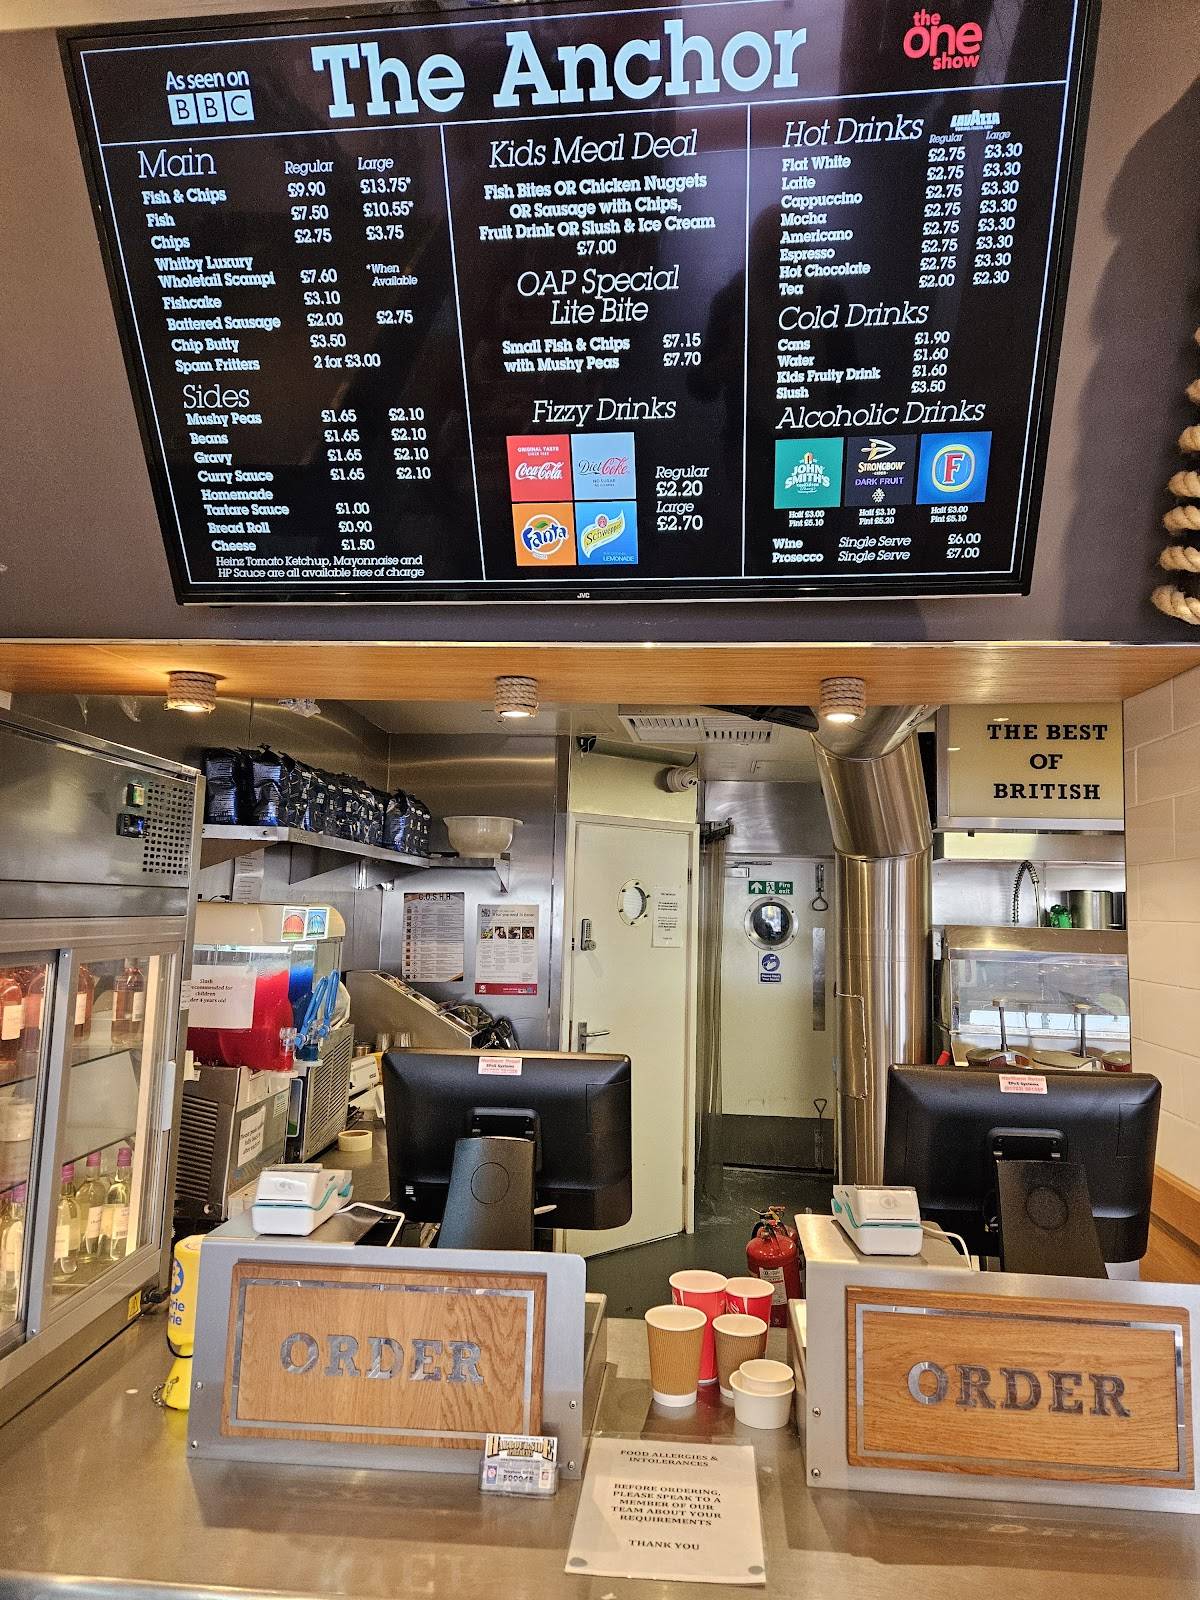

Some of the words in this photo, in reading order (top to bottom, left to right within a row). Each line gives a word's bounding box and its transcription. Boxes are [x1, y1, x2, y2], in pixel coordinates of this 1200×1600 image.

[913, 9, 940, 26] the
[903, 22, 982, 58] one
[933, 52, 979, 70] show
[310, 42, 465, 119] The
[493, 19, 807, 107] Anchor
[166, 72, 186, 91] As
[187, 72, 224, 89] seen
[227, 70, 249, 87] on
[171, 92, 252, 122] BBC
[783, 119, 830, 148] Hot
[835, 114, 924, 145] Drinks
[489, 139, 546, 168] Kids
[552, 133, 624, 164] Meal
[632, 129, 698, 160] Deal
[137, 148, 216, 179] Main
[284, 159, 334, 176] Regular
[358, 157, 394, 172] Large
[782, 159, 809, 172] Flat
[811, 155, 851, 169] White
[287, 181, 326, 199] £9.90
[782, 177, 816, 190] Latte
[142, 191, 171, 205] Fish
[173, 190, 184, 203] &
[186, 188, 227, 205] Chips
[781, 193, 862, 210] Cappuccino
[146, 213, 175, 228] Fish
[781, 213, 827, 226] Mocha
[151, 236, 190, 251] Chips
[780, 230, 853, 244] Americano
[780, 249, 835, 264] Espresso
[154, 257, 203, 273] Whitby
[205, 256, 253, 272] Luxury
[780, 266, 802, 278] Hot
[805, 263, 870, 277] Chocolate
[158, 273, 222, 289] Wholetail
[224, 272, 276, 288] Scampi
[372, 275, 417, 287] Available
[518, 270, 576, 296] OAP
[582, 265, 680, 300] Special
[973, 270, 1009, 285] £2.30
[779, 283, 804, 296] Tea
[163, 295, 222, 310] Fishcake
[550, 300, 594, 325] Lite
[600, 298, 648, 322] Bite
[779, 305, 840, 330] Cold
[845, 301, 929, 328] Drinks
[167, 316, 223, 331] Battered
[224, 316, 281, 331] Sausage
[171, 339, 203, 354] Chip
[206, 338, 239, 353] Butty
[662, 333, 701, 348] £7.15
[778, 339, 810, 351] Cans
[915, 331, 950, 346] £1.90
[175, 360, 213, 374] Spam
[215, 358, 260, 372] Fritters
[777, 354, 814, 367] Water
[183, 384, 249, 409] Sides
[776, 387, 809, 399] Slush
[532, 400, 592, 427] Fizzy
[596, 397, 676, 421] Drinks
[776, 403, 899, 429] Alcoholic
[903, 400, 986, 425] Drinks
[189, 433, 228, 445] Beans
[194, 452, 232, 465] Gravy
[579, 460, 601, 475] Diet
[601, 457, 629, 475] Coke
[792, 464, 825, 476] JOHN
[858, 462, 905, 472] STRONGBOW
[942, 453, 965, 485] F
[785, 473, 830, 488] SMITH'S
[201, 489, 273, 500] Homemade
[656, 481, 702, 497] £2.20
[875, 508, 896, 516] £3.10
[208, 523, 245, 534] Bread
[247, 522, 270, 534] Roll
[338, 521, 372, 533] £0.90
[657, 515, 702, 531] £2.70
[522, 522, 568, 550] Fanta
[773, 538, 803, 549] Wine
[839, 536, 876, 549] Single
[878, 535, 911, 546] Serve
[948, 533, 981, 545] £6.00
[212, 541, 256, 551] Cheese
[216, 557, 244, 567] Heinz
[245, 557, 284, 566] Tomato
[285, 556, 331, 567] Ketchup,
[333, 556, 398, 567] Mayonnaise
[400, 555, 423, 565] and
[772, 553, 823, 563] Prosecco
[218, 569, 232, 578] HP
[234, 569, 265, 578] Sauce
[267, 569, 285, 577] are
[286, 568, 299, 577] all
[302, 568, 351, 578] available
[352, 568, 372, 577] free
[374, 568, 384, 577] of
[386, 567, 425, 579] charge
[987, 724, 1037, 740] THE
[1046, 724, 1108, 740] BEST
[1029, 754, 1063, 769] OF
[993, 784, 1100, 800] BRITISH
[280, 1331, 484, 1385] ORDER
[907, 1360, 1130, 1418] ORDER
[629, 1457, 709, 1467] INTOLERANCES
[652, 1452, 708, 1460] ALLERGIES
[613, 1490, 655, 1499] PLEASE
[656, 1493, 692, 1501] SPEAK
[614, 1483, 657, 1491] BEFORE
[660, 1486, 720, 1496] ORDERING,
[619, 1499, 669, 1508] MEMBER
[611, 1506, 644, 1514] TEAM
[646, 1508, 686, 1516] ABOUT
[689, 1511, 721, 1519] YOUR
[620, 1515, 712, 1526] REQUIREMENTS
[629, 1539, 672, 1548] THANK
[675, 1541, 700, 1550] YOU
